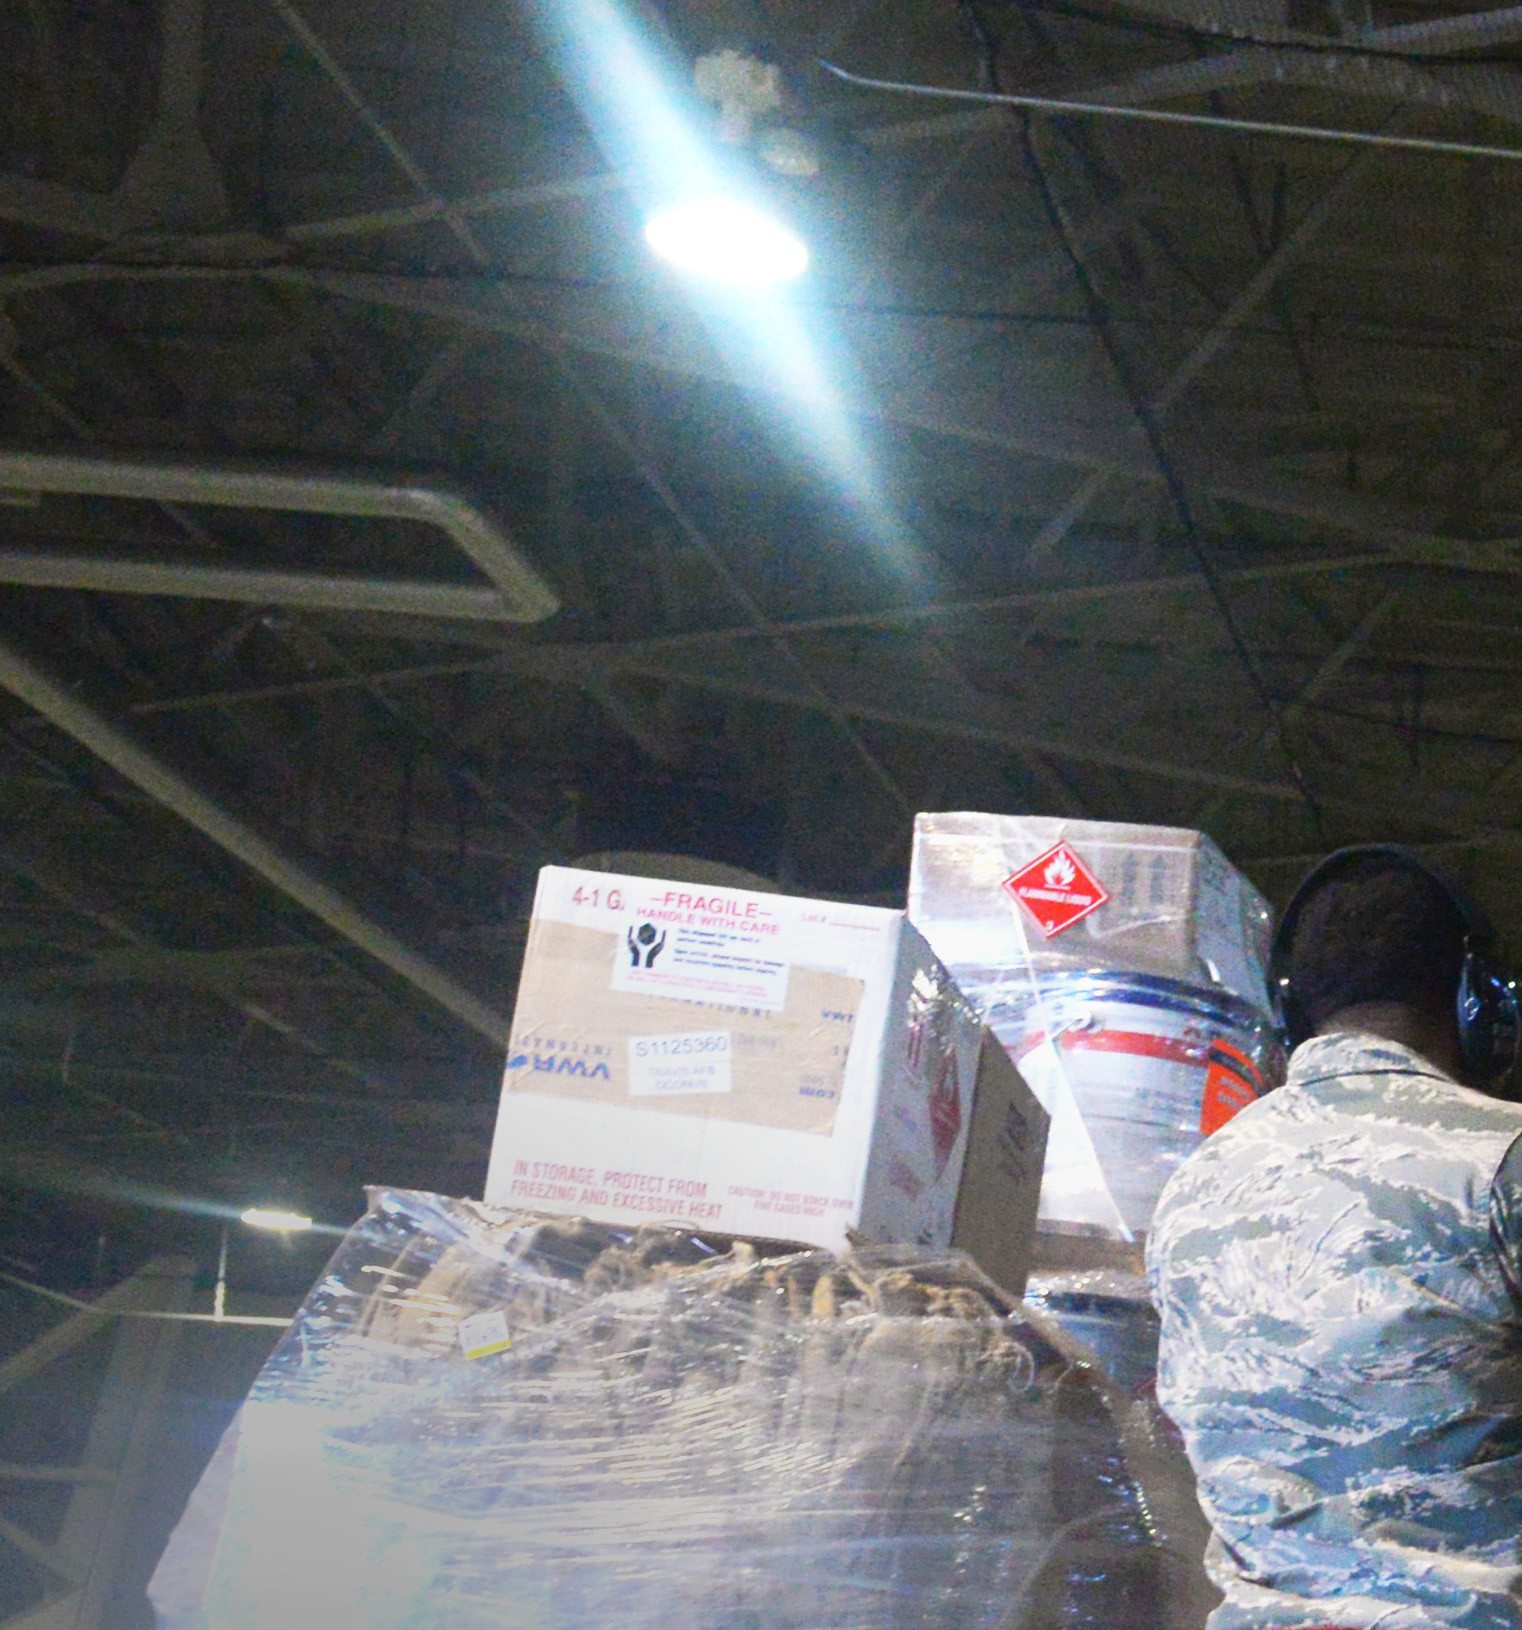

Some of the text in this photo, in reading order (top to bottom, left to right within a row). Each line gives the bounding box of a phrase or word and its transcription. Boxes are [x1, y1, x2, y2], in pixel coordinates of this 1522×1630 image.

[636, 907, 781, 936] HANDLE WITH CARE
[636, 1036, 728, 1058] S1125360
[514, 1159, 529, 1177] IN
[602, 1169, 664, 1193] PROTECT
[667, 1178, 709, 1199] FROM
[511, 1180, 723, 1220] FREEZING AND EXCESSIVE HEAT
